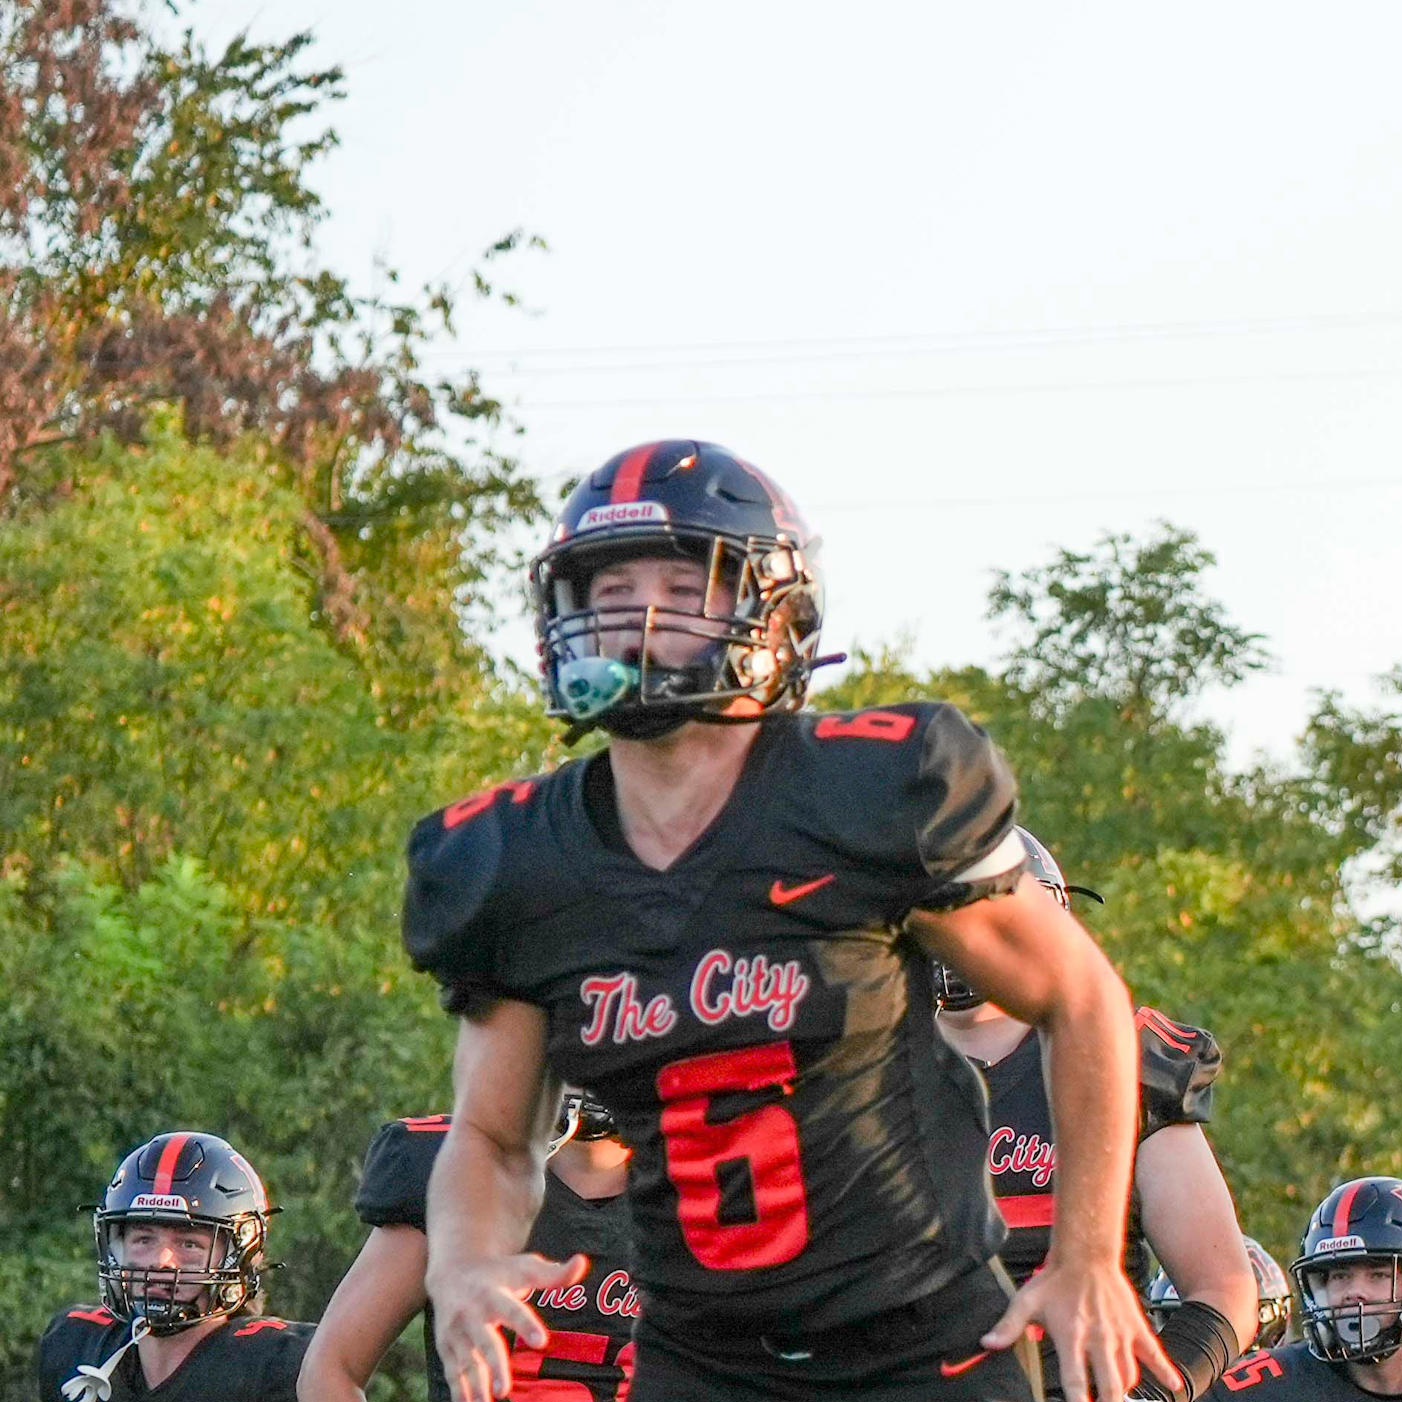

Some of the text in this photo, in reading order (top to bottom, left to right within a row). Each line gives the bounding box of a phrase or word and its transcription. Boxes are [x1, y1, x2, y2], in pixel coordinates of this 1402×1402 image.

[587, 506, 653, 523] Riddell
[580, 948, 808, 1047] The City
[658, 1041, 808, 1271] 6
[988, 1126, 1056, 1187] City
[137, 1196, 179, 1208] Riddell
[1319, 1238, 1357, 1251] Riddell
